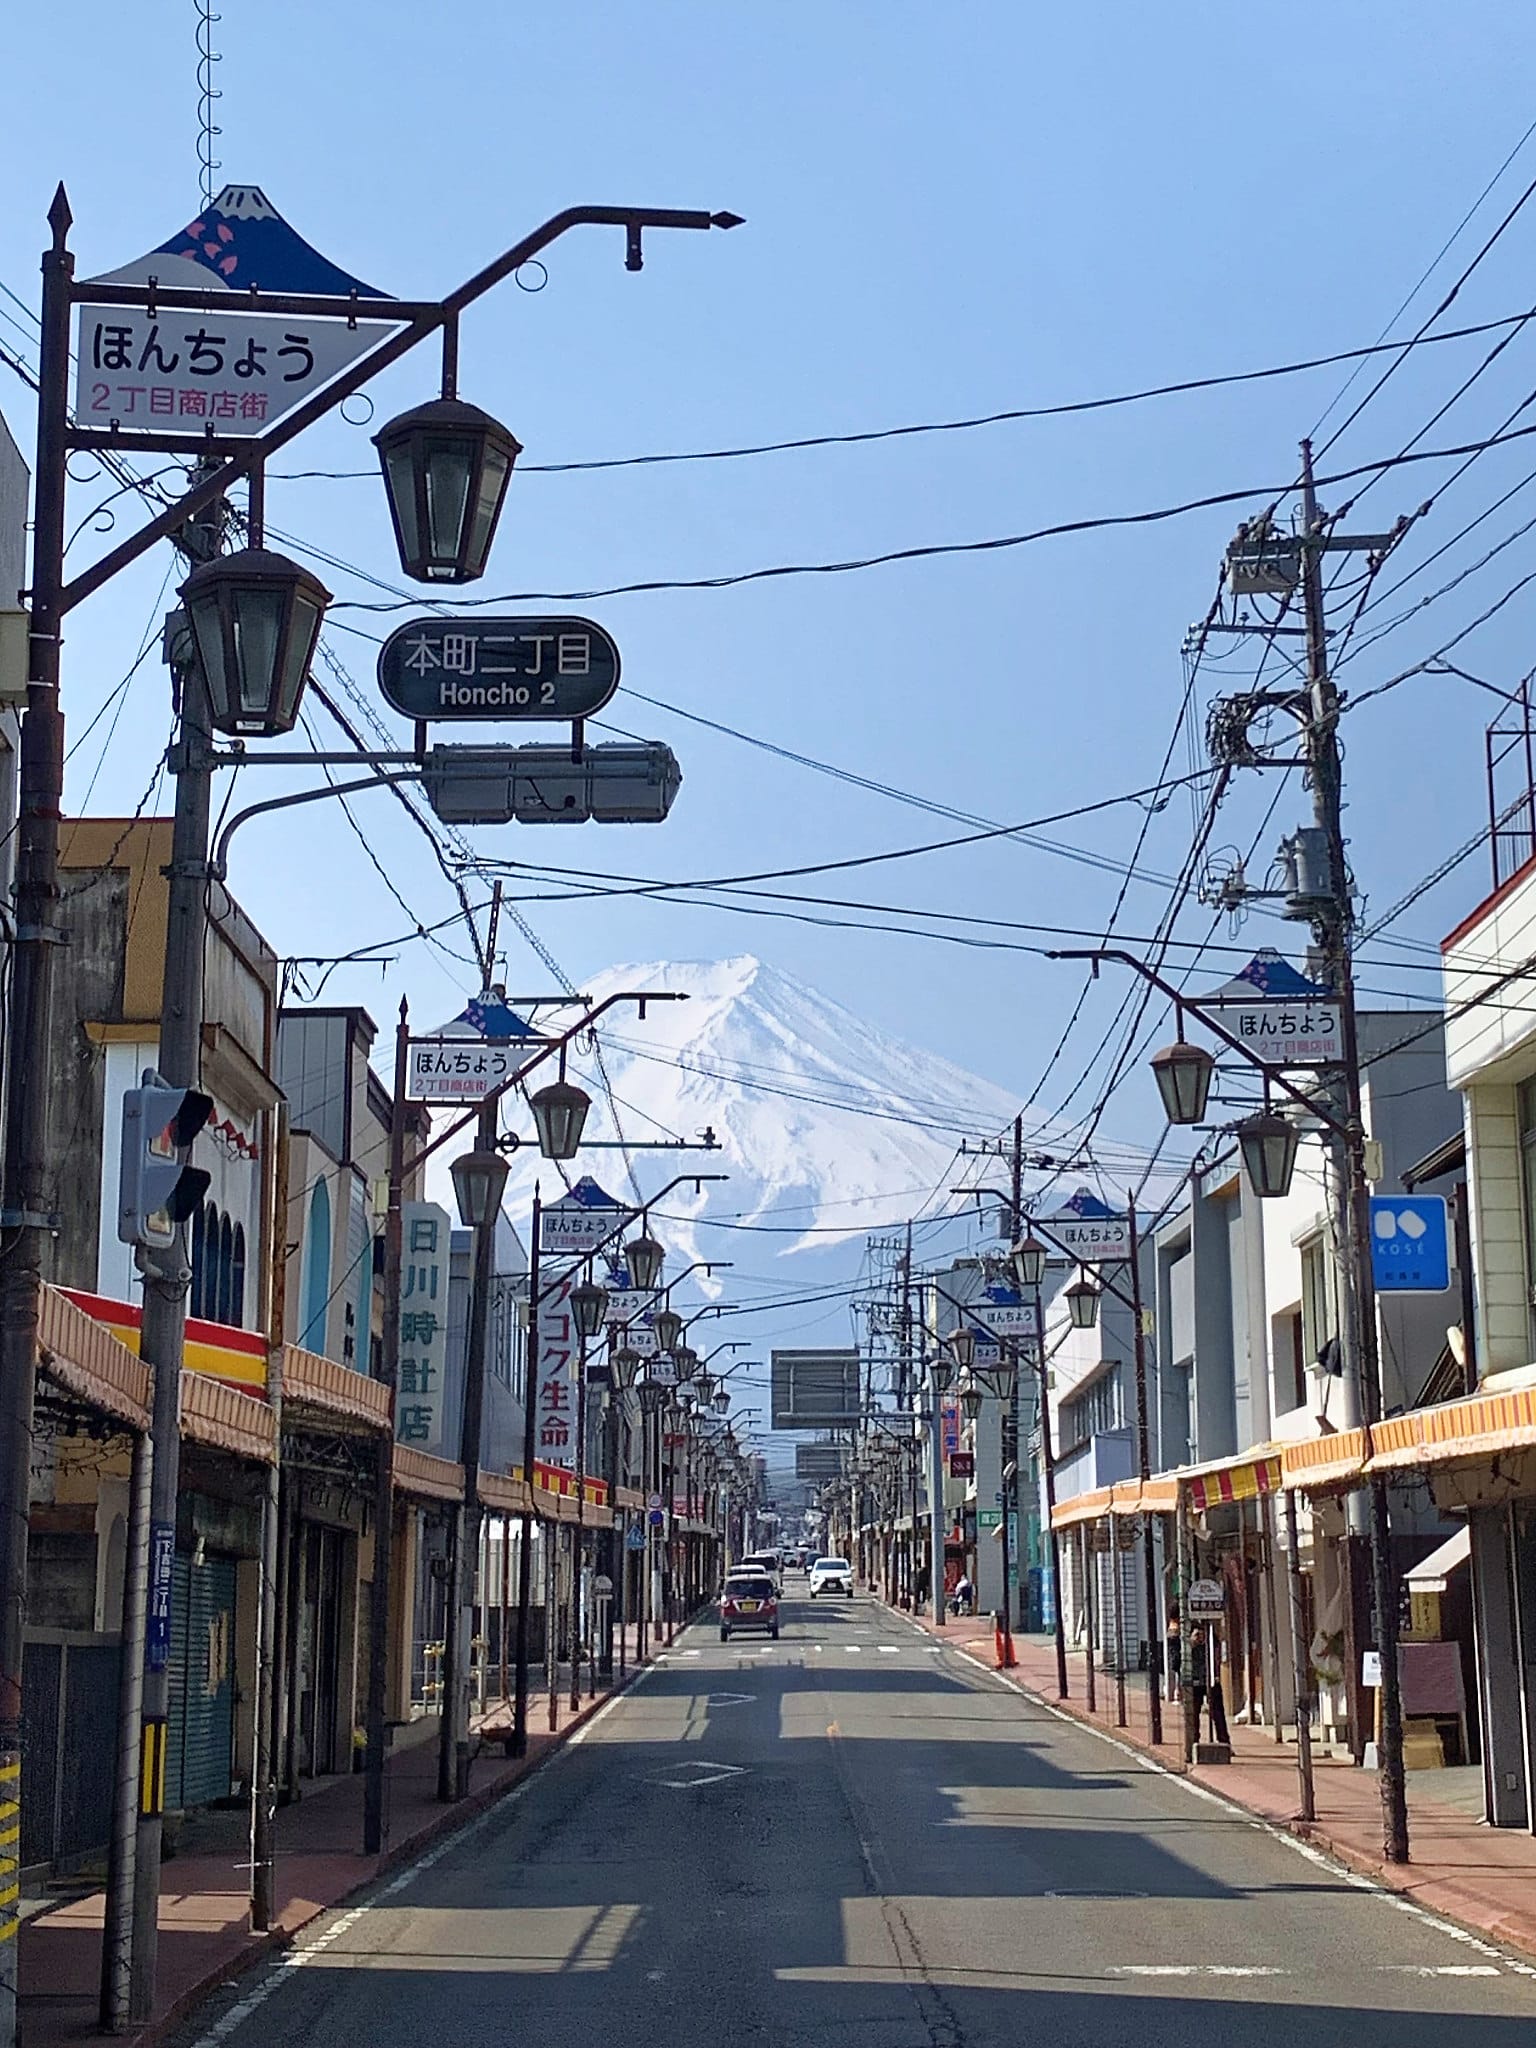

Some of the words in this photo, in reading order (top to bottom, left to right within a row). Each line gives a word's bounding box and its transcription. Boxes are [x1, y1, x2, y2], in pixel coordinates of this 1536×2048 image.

[93, 323, 314, 382] ほんちょう
[91, 383, 268, 420] 2丁目商店街
[404, 633, 590, 677] 本町二丁目
[440, 682, 530, 705] Honcho
[540, 681, 556, 704] 2
[1240, 1011, 1334, 1036] ほんちょう
[416, 1052, 507, 1074] ほんちょう
[546, 1218, 607, 1233] ほんちょう
[1064, 1227, 1124, 1242] ほんちょう
[1378, 1241, 1424, 1255] KOSÉ
[987, 1310, 1032, 1323] ほんちょう
[397, 1219, 440, 1442] 日川時計店
[539, 1278, 572, 1447] フコク生命
